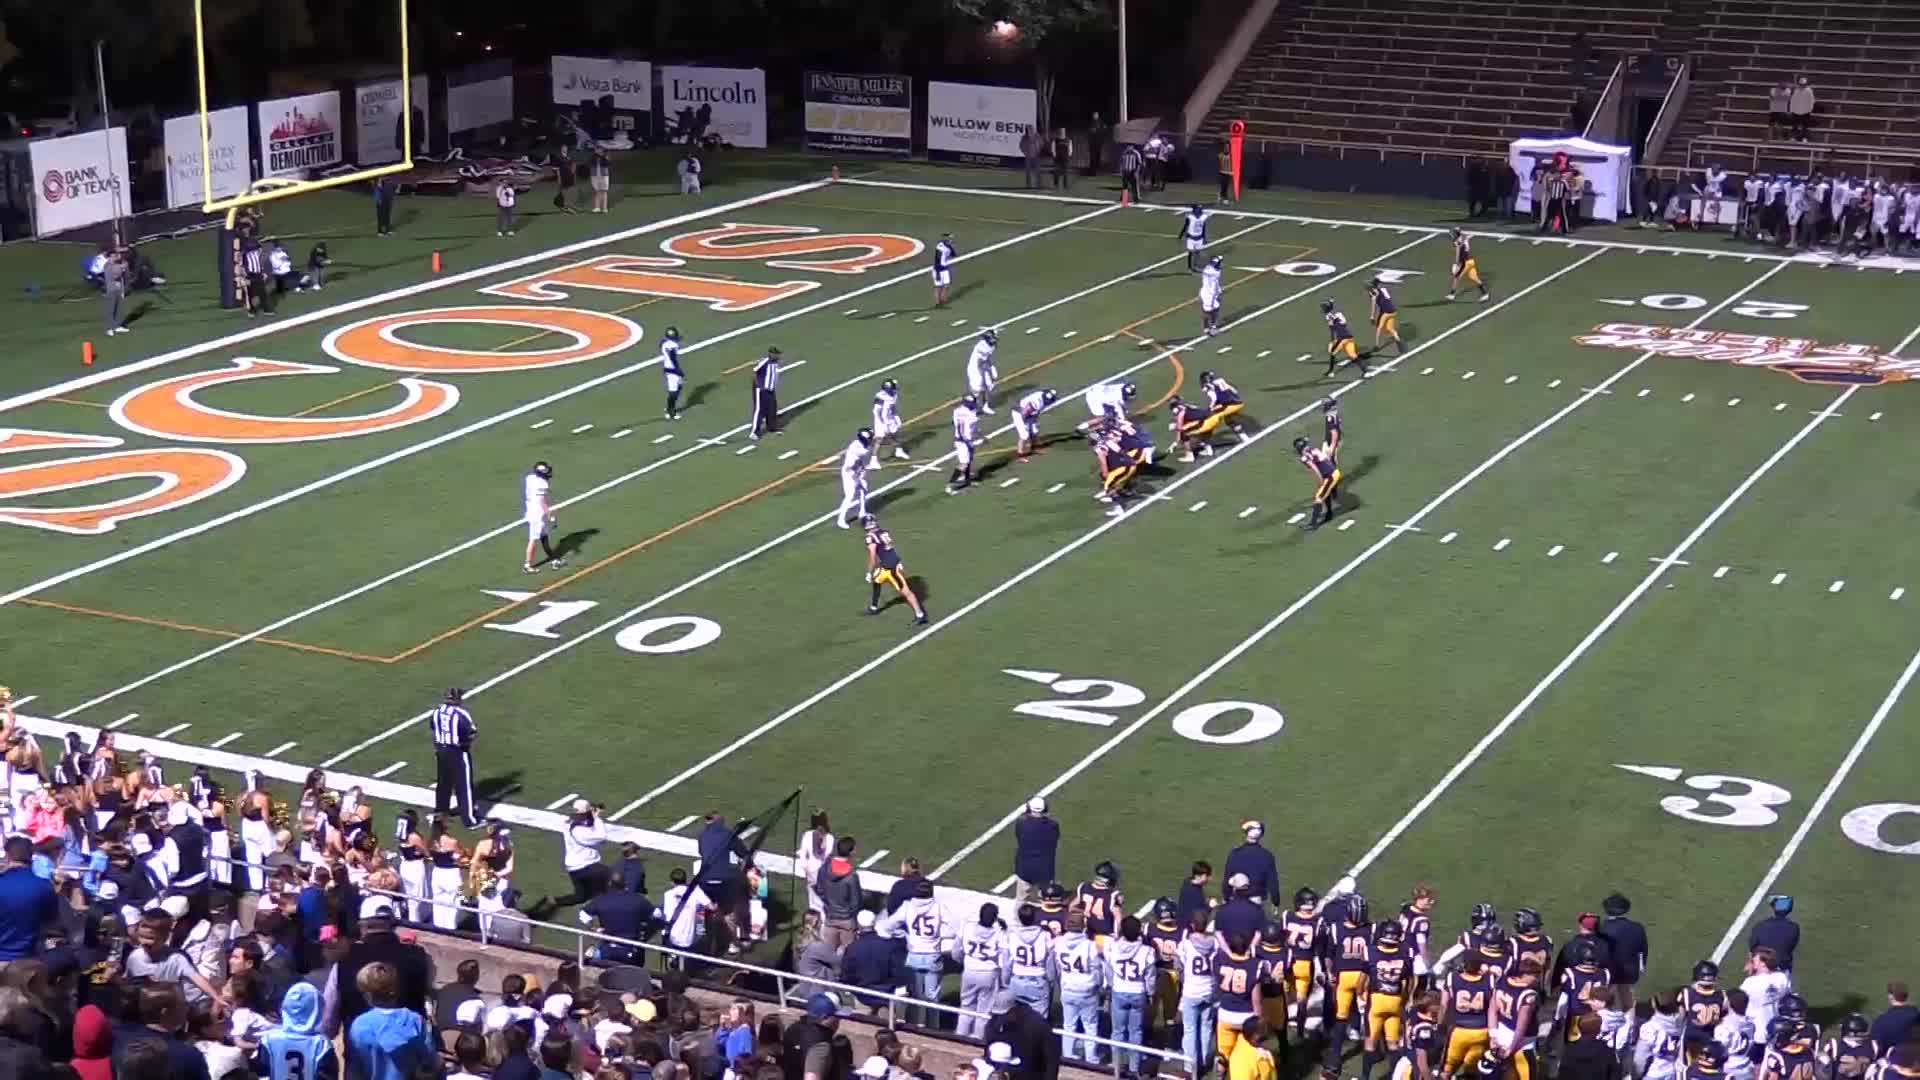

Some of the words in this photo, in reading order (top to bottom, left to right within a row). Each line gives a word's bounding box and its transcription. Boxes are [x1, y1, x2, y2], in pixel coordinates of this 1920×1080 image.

[612, 78, 642, 94] Bank
[672, 78, 756, 104] Lincoln
[930, 114, 991, 131] WILLOW
[995, 120, 1034, 134] BEN
[270, 143, 335, 172] DEMOLITION
[64, 166, 98, 185] BANK
[66, 185, 82, 200] OF
[84, 174, 121, 196] TEXAS
[911, 913, 935, 937] 45
[1287, 922, 1314, 950] 73
[967, 940, 998, 962] 75
[1016, 945, 1039, 967] 91
[1060, 952, 1085, 974] 54
[1456, 989, 1485, 1014] 64
